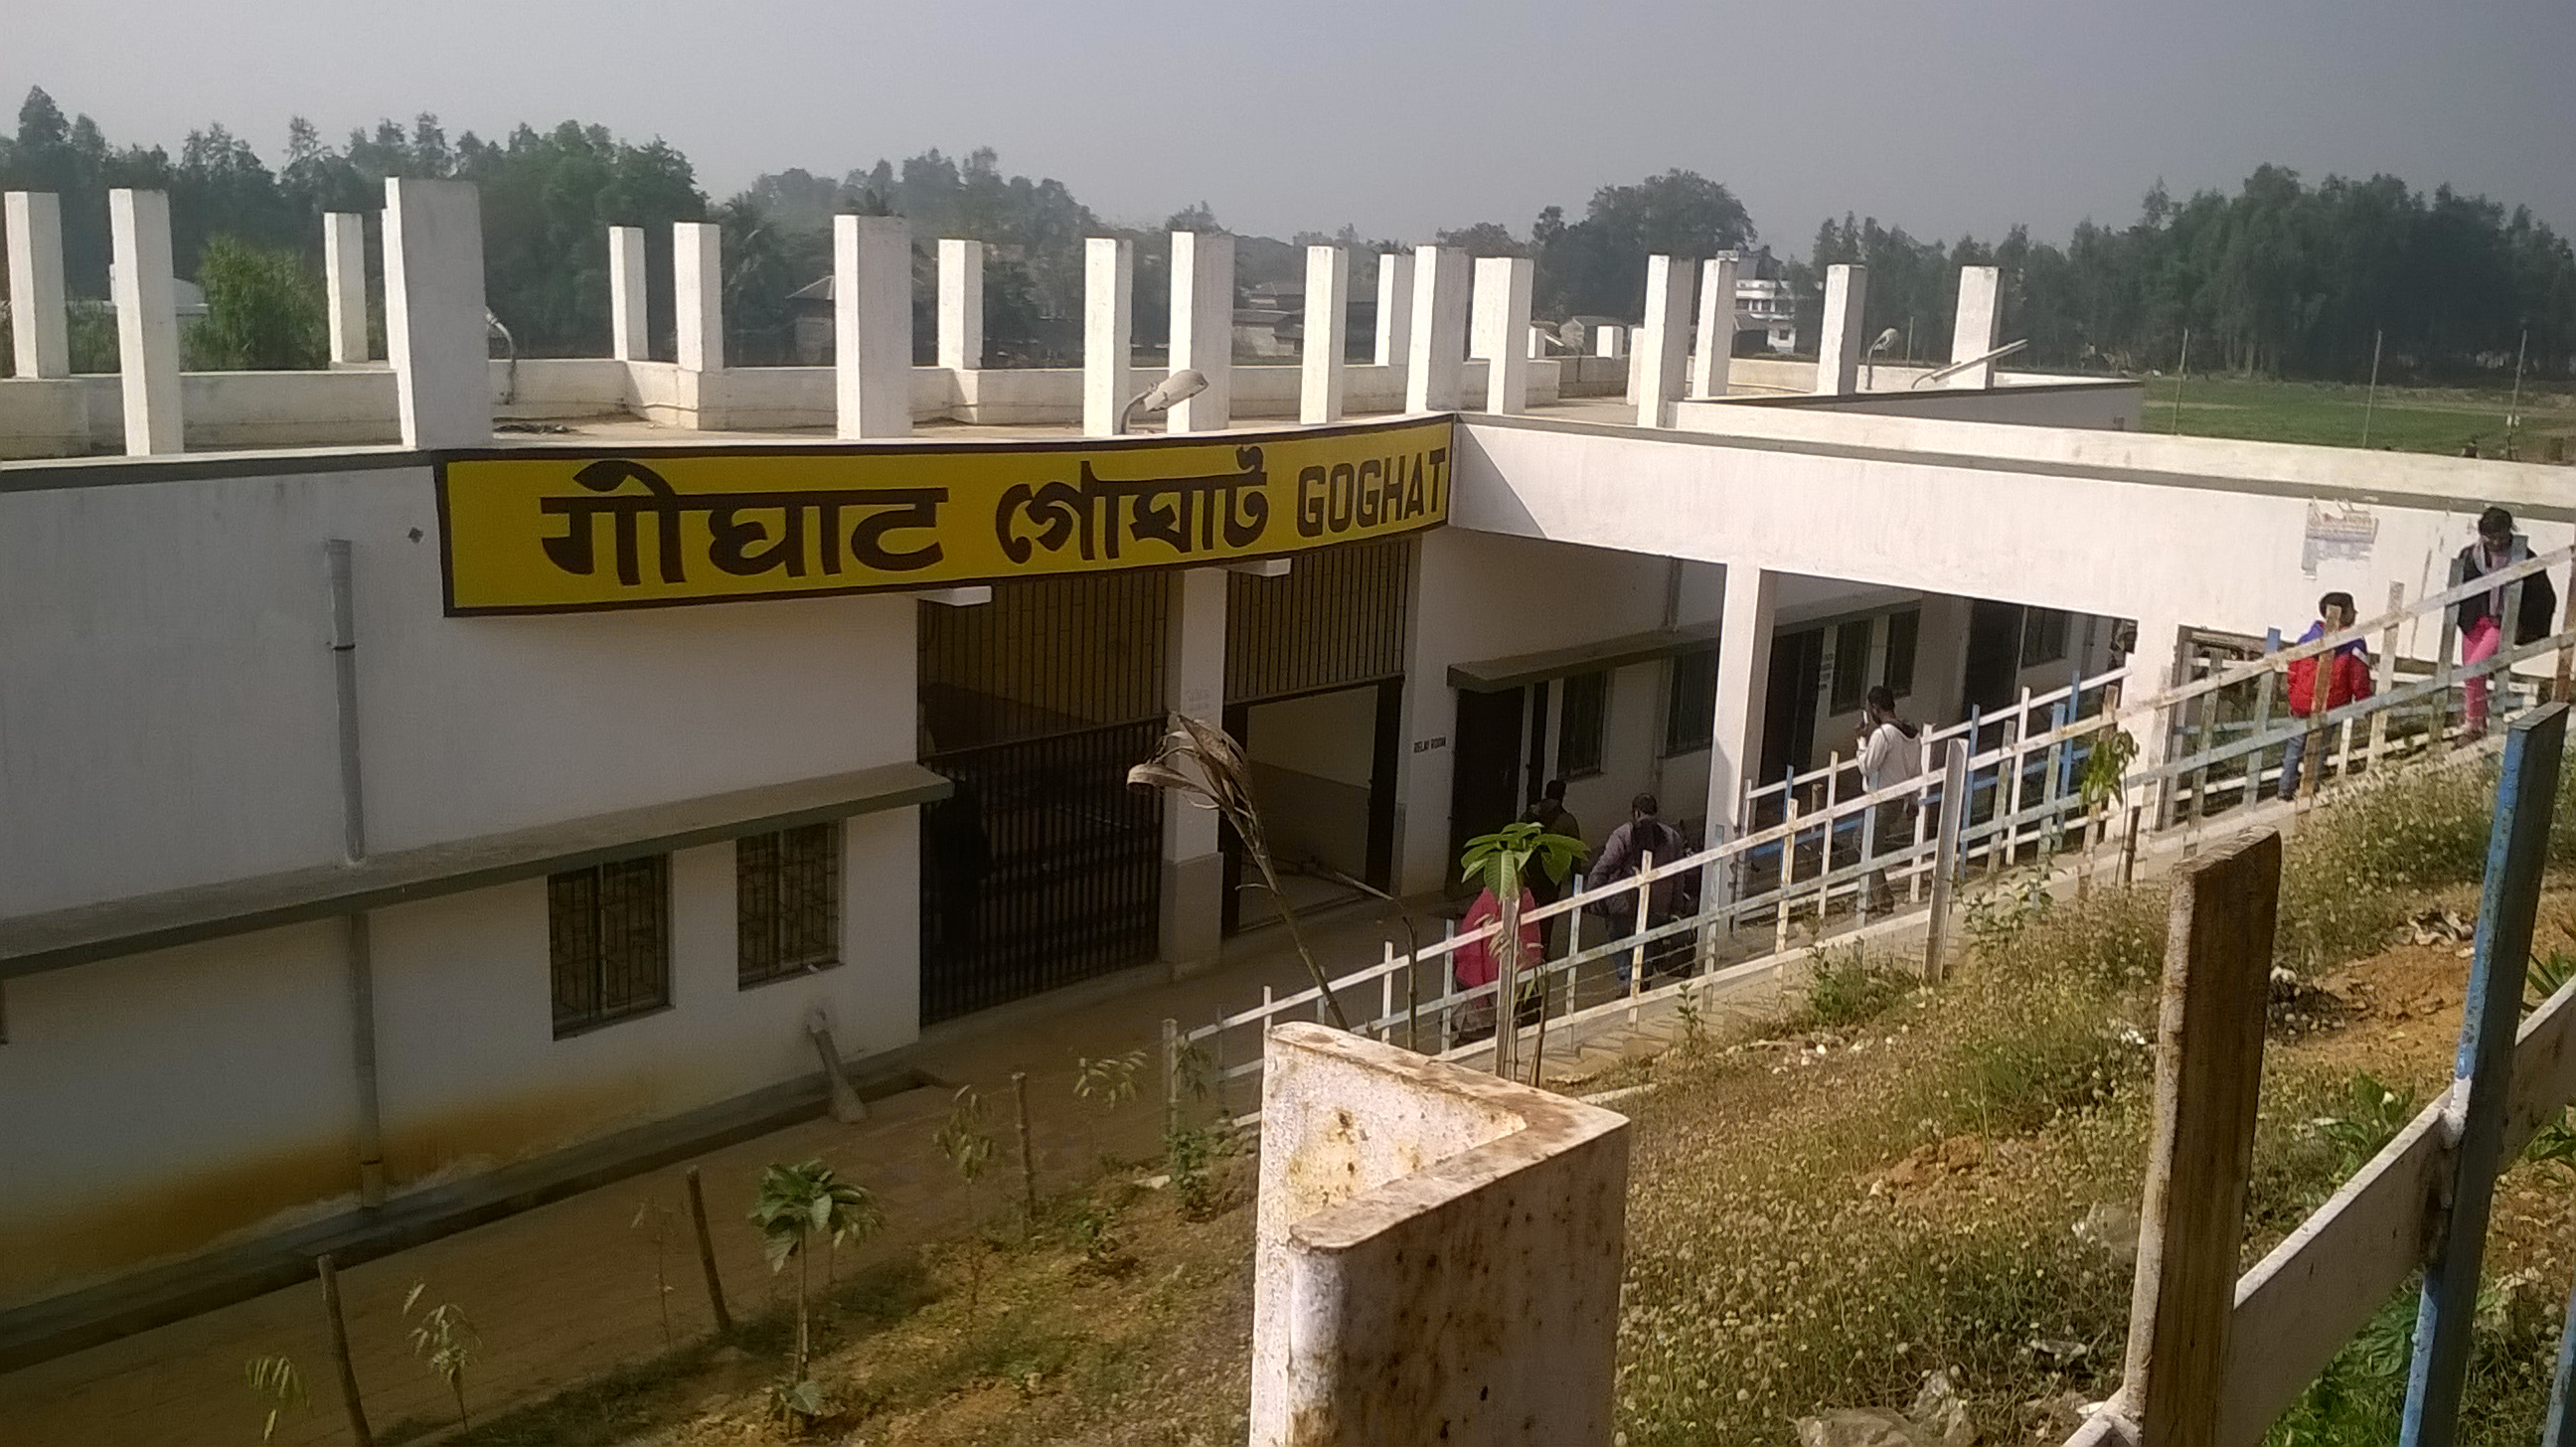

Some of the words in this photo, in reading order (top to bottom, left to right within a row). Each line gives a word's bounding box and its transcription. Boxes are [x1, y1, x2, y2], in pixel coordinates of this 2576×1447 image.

[541, 459, 949, 586] गोघाट
[995, 445, 1268, 564] গোঘাট
[1296, 447, 1446, 538] GOGHAT
